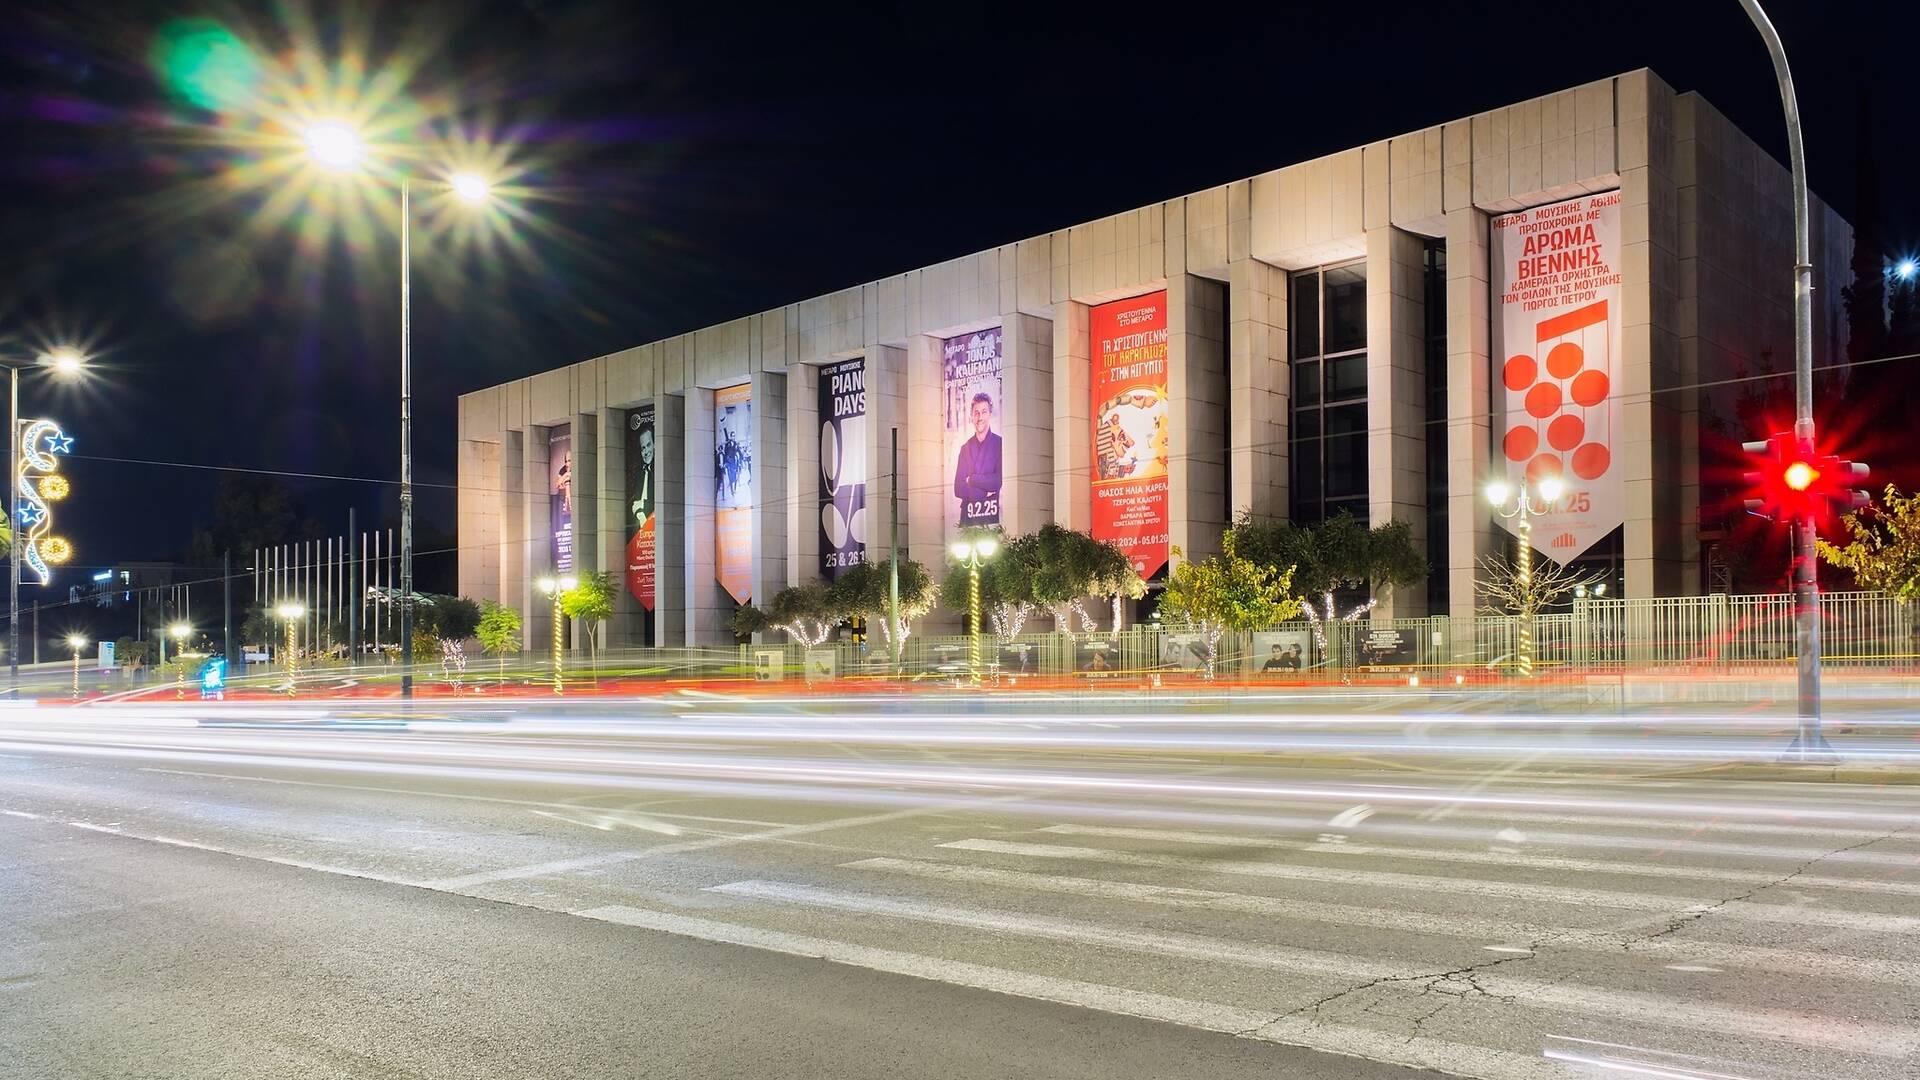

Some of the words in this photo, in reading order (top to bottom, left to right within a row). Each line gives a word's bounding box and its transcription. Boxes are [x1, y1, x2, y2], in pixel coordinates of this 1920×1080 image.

[1493, 214, 1528, 230] ΜΕΓΑΡΟ
[1535, 202, 1581, 220] ΜΟΥΣΙΚΗΣ
[1519, 214, 1583, 235] ΠΡΩΤΟΧΡΟΝΙΑ
[1586, 210, 1600, 221] ΜΕ
[1522, 223, 1596, 256] ΑΡΩΜΑ
[1518, 244, 1602, 280] ΒΙΕΝΝΗΣ
[1500, 293, 1518, 304] ΤΩΝ
[1521, 287, 1551, 300] ΦΙΛΩΝ
[1554, 284, 1571, 294] ΤΗΣ
[1574, 274, 1621, 291] ΜΟΥΣΙΚΗΣ
[1511, 274, 1559, 292] ΚΑΜΕΡΑΤΑ
[1562, 265, 1609, 282] ΟΡΧΗΣΤΡΑ
[1523, 298, 1558, 312] ΓΙΩΡΓΟΣ
[1561, 290, 1597, 304] ΠΕΤΡΟΥ
[1102, 339, 1111, 354] ΤΑ
[1103, 353, 1116, 368] ΤΟΥ
[1110, 365, 1129, 382] ΣΤΗΝ
[1130, 360, 1163, 378] ΑΙΓΥΠΤΟ
[834, 392, 865, 416] DAYS
[1145, 482, 1168, 494] ΚΑΡΕΛ
[967, 500, 997, 518] 9.2.25
[826, 553, 837, 567] 25
[838, 552, 846, 566] &
